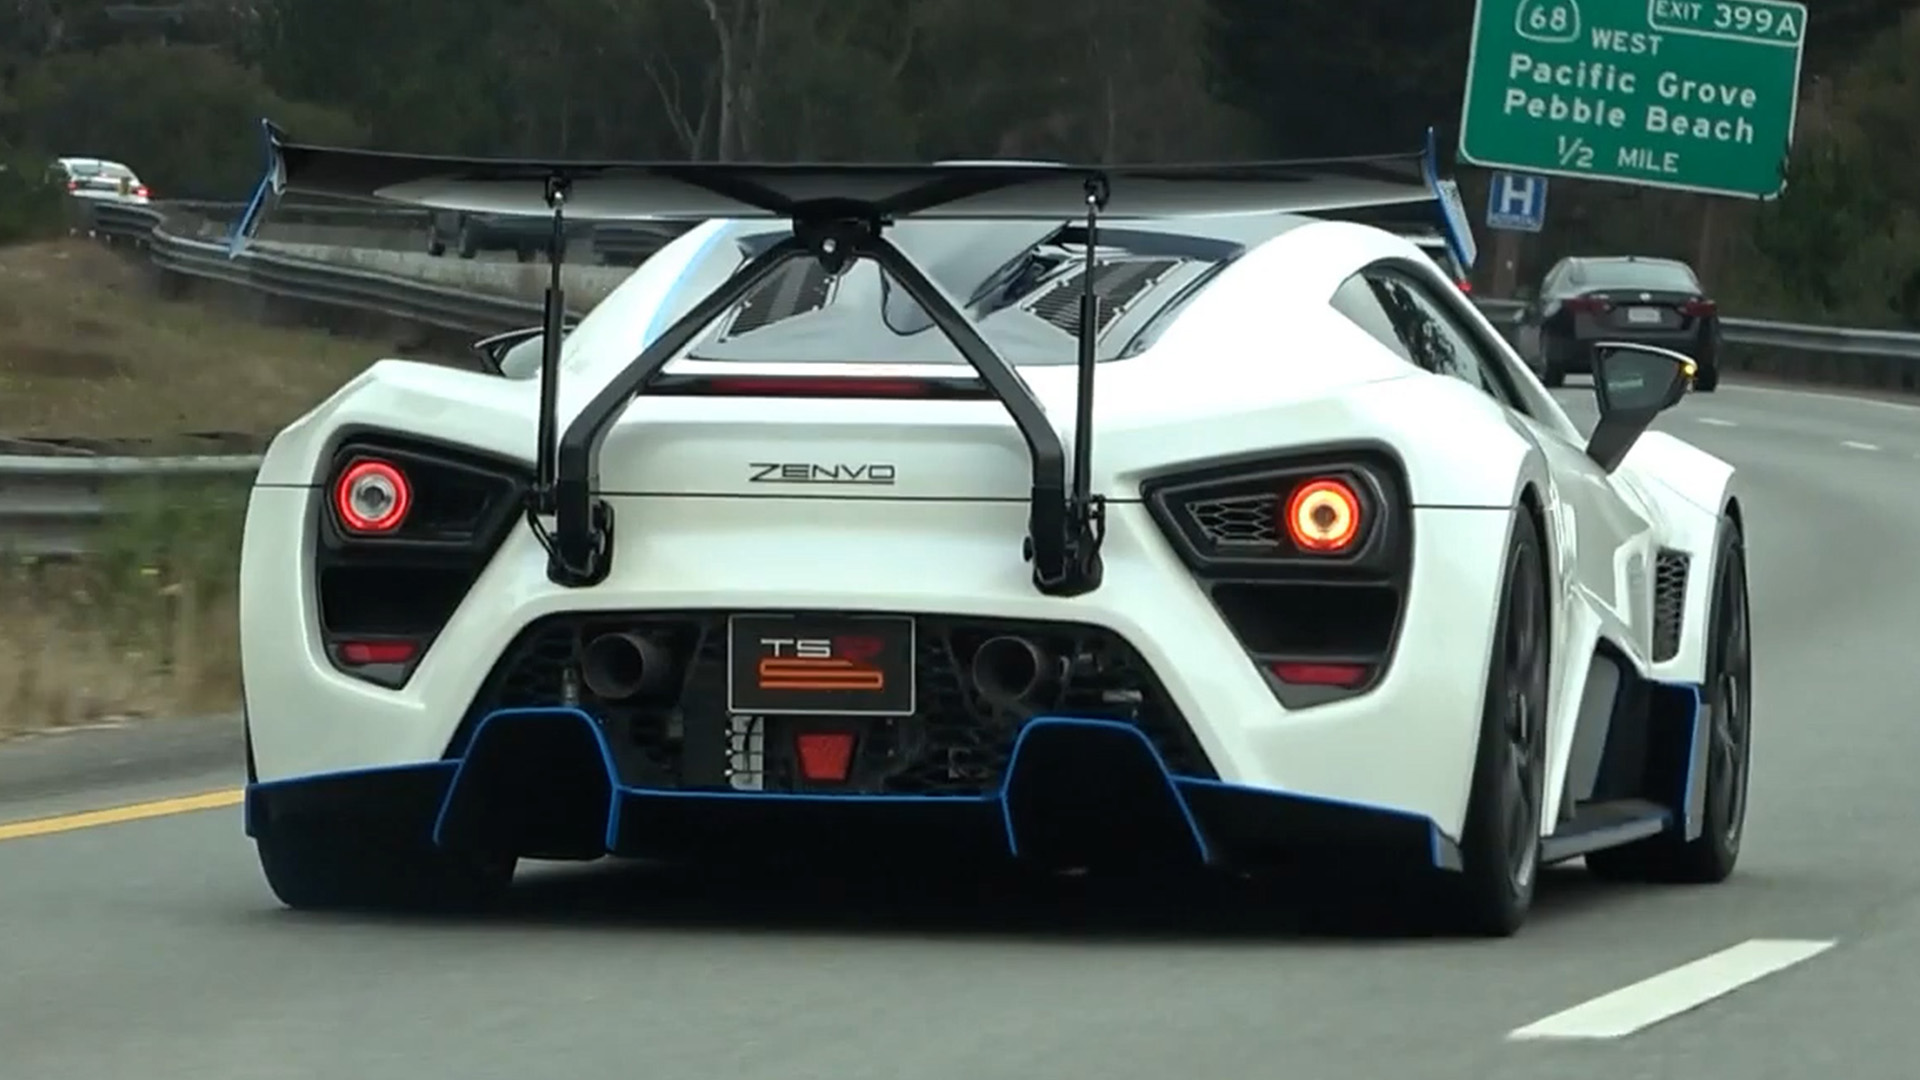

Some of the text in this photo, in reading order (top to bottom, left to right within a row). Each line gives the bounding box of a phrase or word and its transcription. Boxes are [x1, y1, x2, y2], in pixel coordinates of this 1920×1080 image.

[1529, 7, 1567, 32] 68
[1655, 0, 1798, 38] EXIT 399A
[1591, 27, 1663, 57] WEST
[1509, 53, 1757, 108] Pacific Grove
[1504, 88, 1755, 144] Pebble Beach
[1617, 148, 1680, 173] MILE
[1499, 176, 1535, 216] H
[749, 462, 896, 485] ZENVO
